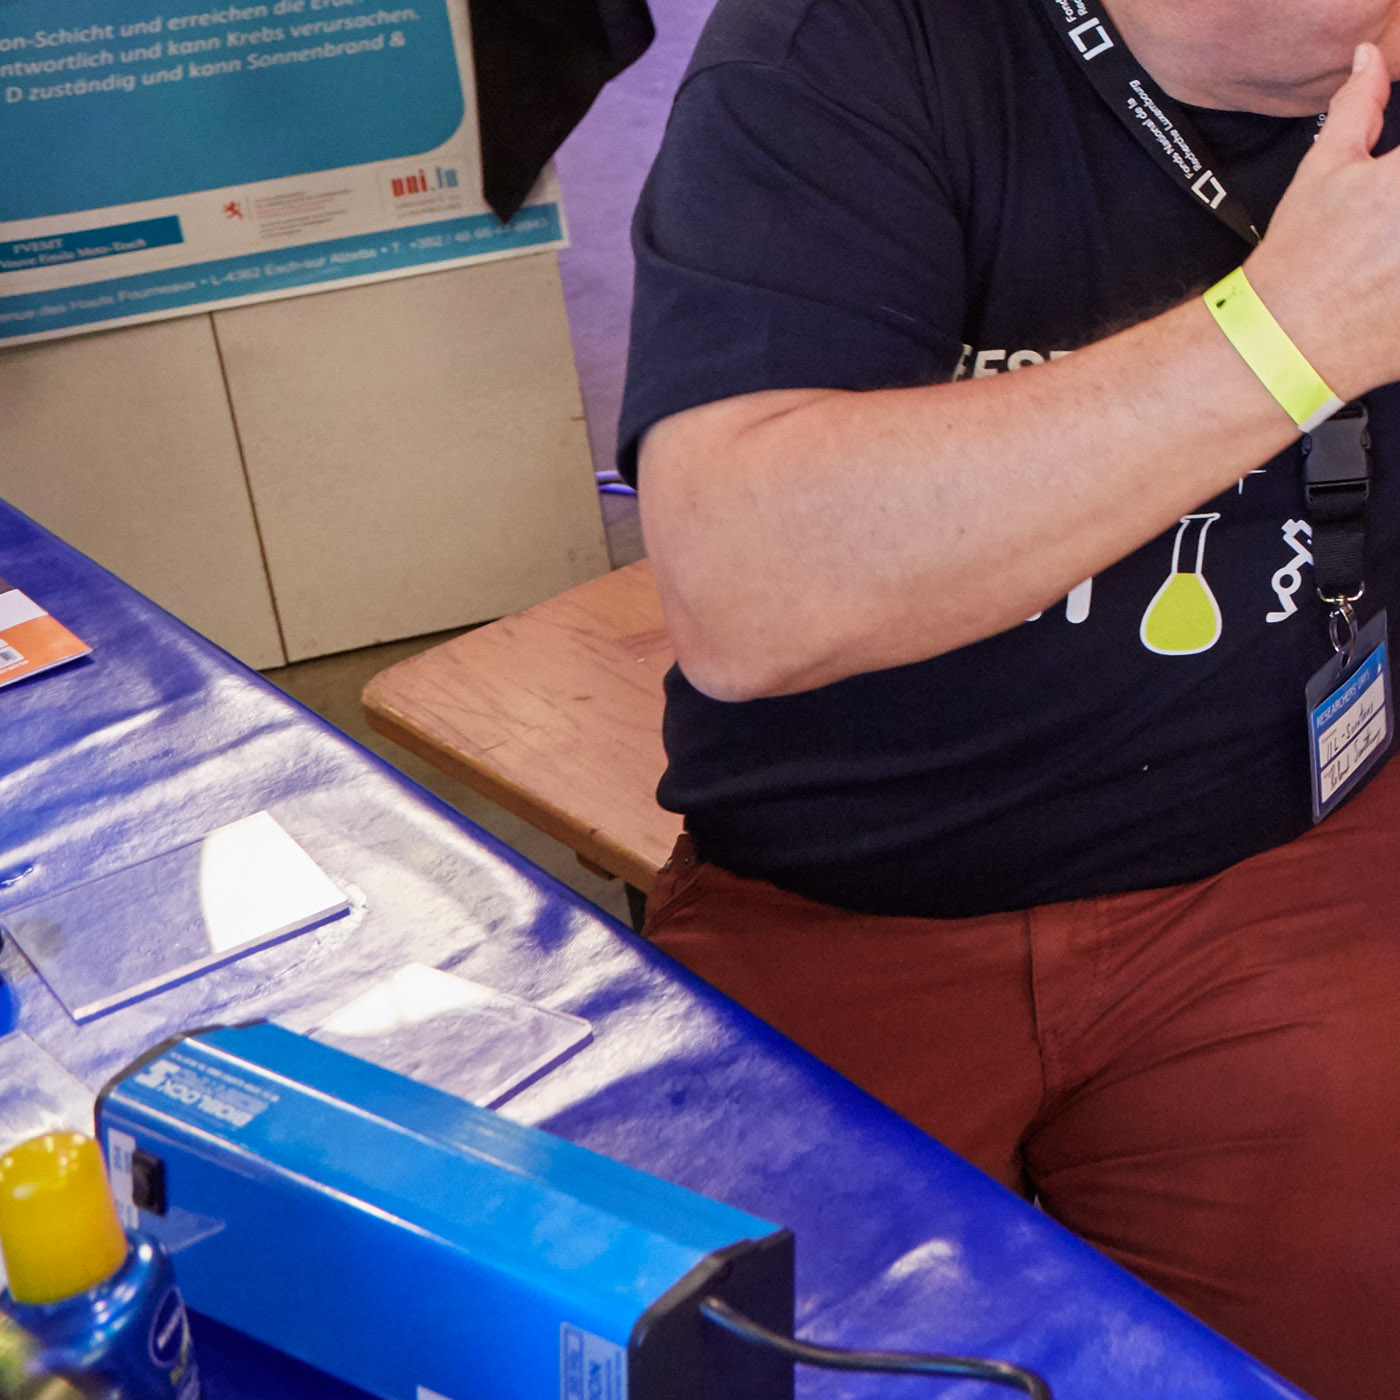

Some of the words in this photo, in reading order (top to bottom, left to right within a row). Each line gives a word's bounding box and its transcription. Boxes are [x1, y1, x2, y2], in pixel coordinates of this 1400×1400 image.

[120, 16, 162, 38] und
[167, 2, 269, 32] erreichen
[120, 42, 162, 65] und
[167, 34, 221, 57] kann
[227, 26, 286, 49] Krebs
[290, 7, 420, 38] verursachen.
[6, 86, 23, 104] D
[29, 71, 137, 102] zuständig
[142, 64, 184, 86] und
[189, 56, 242, 79] kann
[247, 33, 385, 71] Sonnenbrand
[389, 29, 406, 48] &
[1126, 97, 1138, 110] la
[1129, 79, 1174, 131] Luxembourg
[1134, 106, 1148, 120] de
[1141, 118, 1175, 155] National
[1170, 129, 1202, 172] Recherche
[1172, 152, 1195, 179] Fonds
